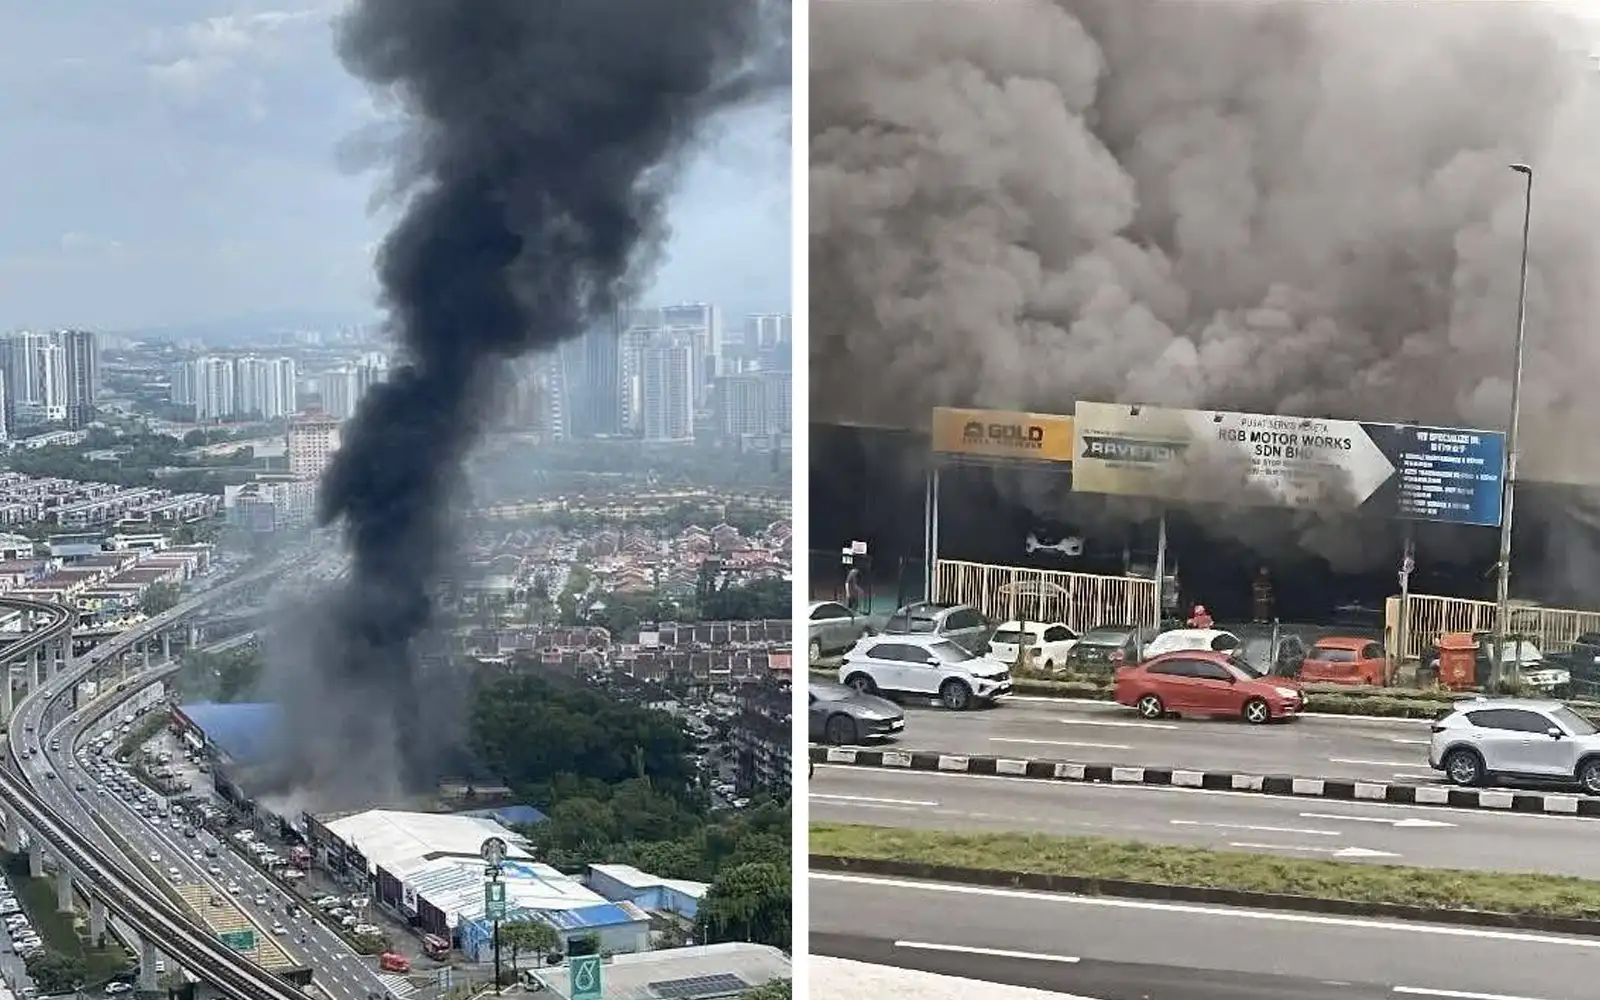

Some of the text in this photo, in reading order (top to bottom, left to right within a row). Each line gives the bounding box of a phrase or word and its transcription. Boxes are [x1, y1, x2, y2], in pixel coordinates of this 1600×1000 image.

[988, 423, 1044, 441] GOLD
[1219, 428, 1352, 450] RGB MOTOR WORKS
[1255, 444, 1313, 459] SDN BHD
